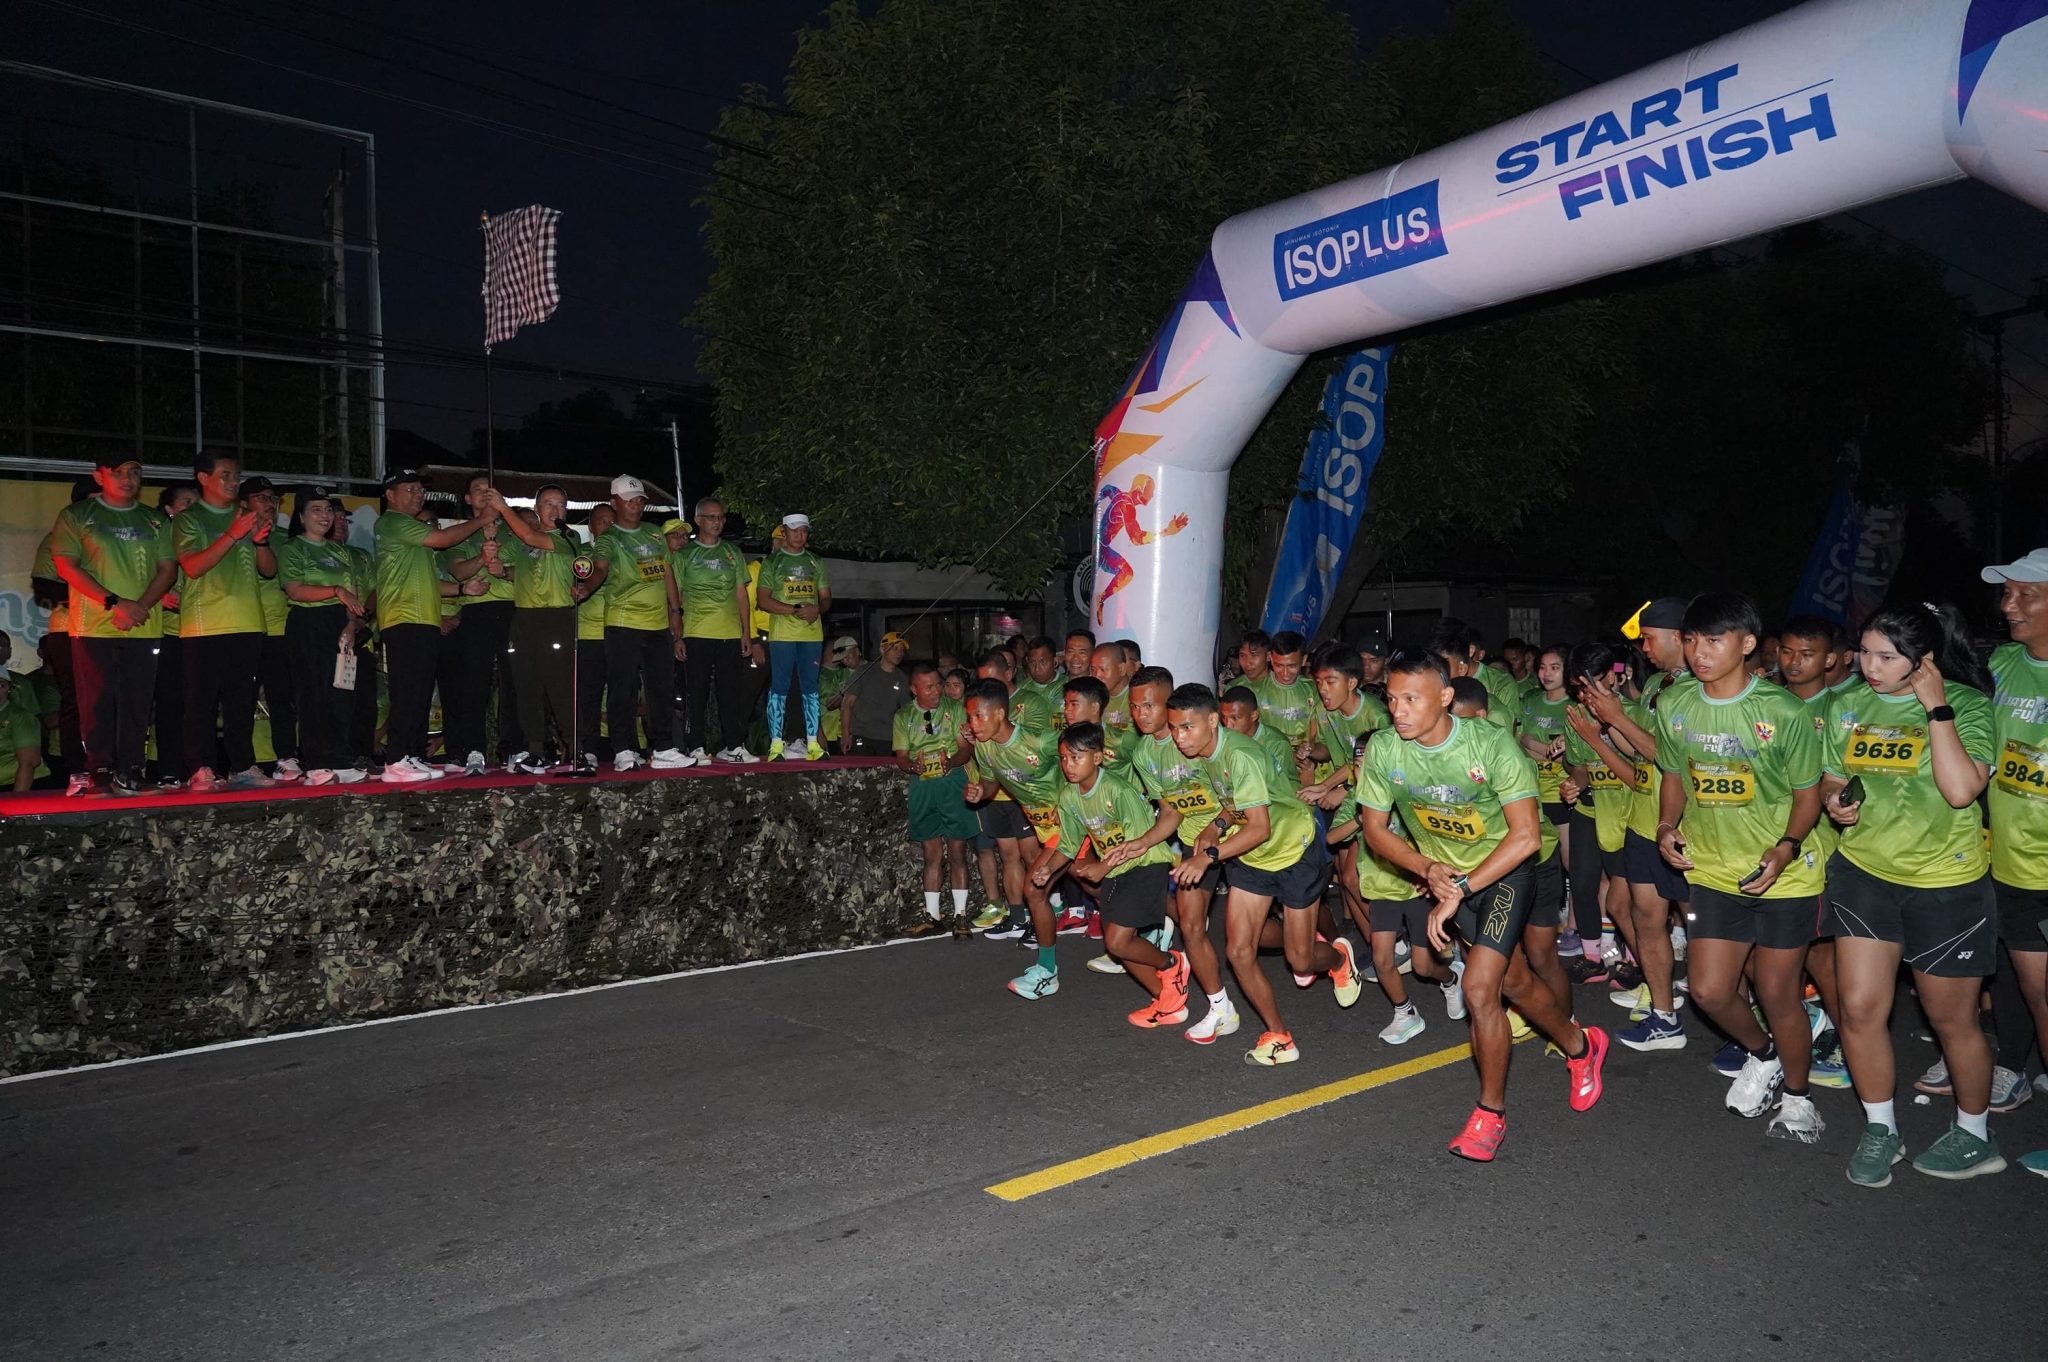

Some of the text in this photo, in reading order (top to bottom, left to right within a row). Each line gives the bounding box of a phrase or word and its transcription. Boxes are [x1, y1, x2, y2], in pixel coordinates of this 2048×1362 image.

[1495, 63, 1739, 184] START
[1558, 92, 1838, 221] FINISH
[1284, 207, 1430, 290] ISOPLUS
[642, 561, 665, 576] 9368
[787, 584, 814, 594] 9443
[1852, 741, 1914, 761] 9636
[1692, 776, 1746, 795] 9288
[1168, 794, 1207, 810] 9026
[1427, 815, 1476, 836] 9391
[1483, 882, 1515, 943] 2XU
